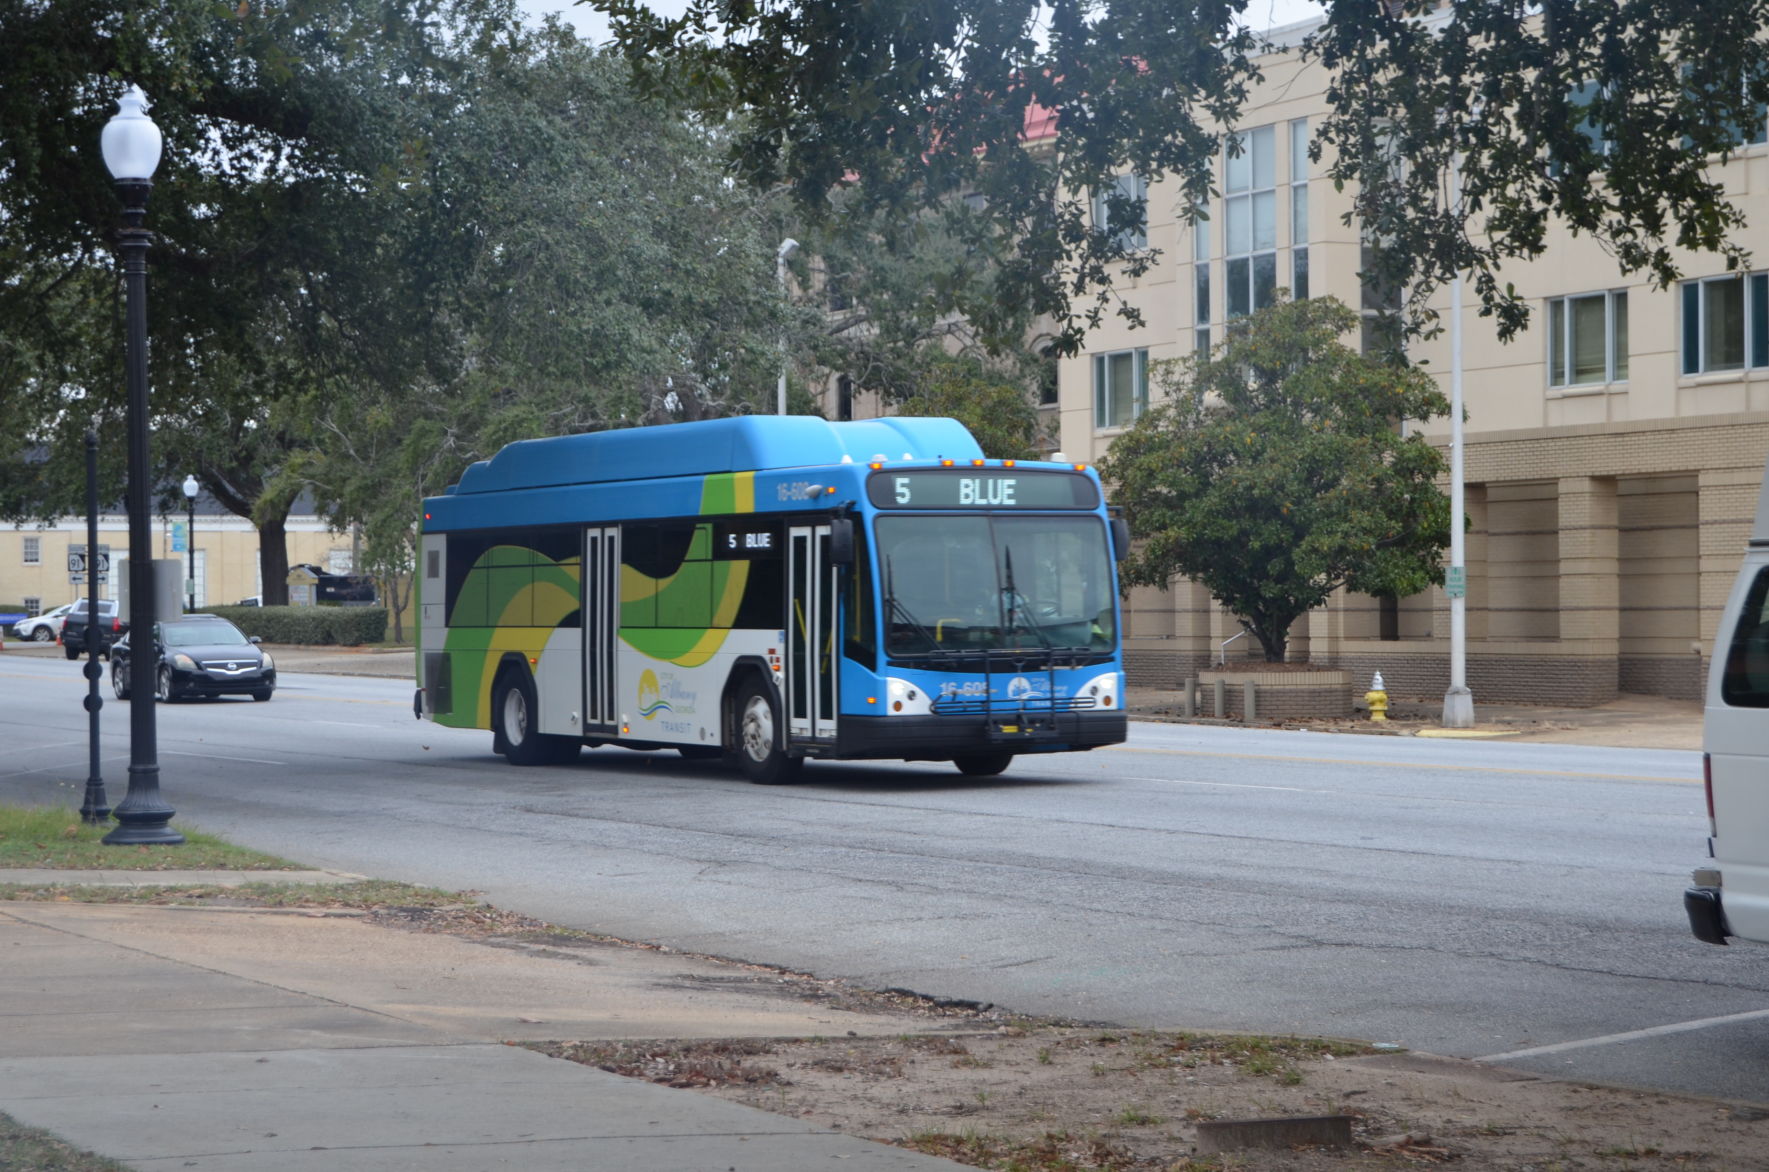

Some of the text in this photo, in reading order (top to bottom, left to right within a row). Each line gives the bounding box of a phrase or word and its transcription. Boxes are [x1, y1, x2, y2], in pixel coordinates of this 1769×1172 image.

[895, 477, 1017, 505] 5 BLUE
[728, 532, 771, 549] 5 BLUE
[70, 558, 80, 569] 91
